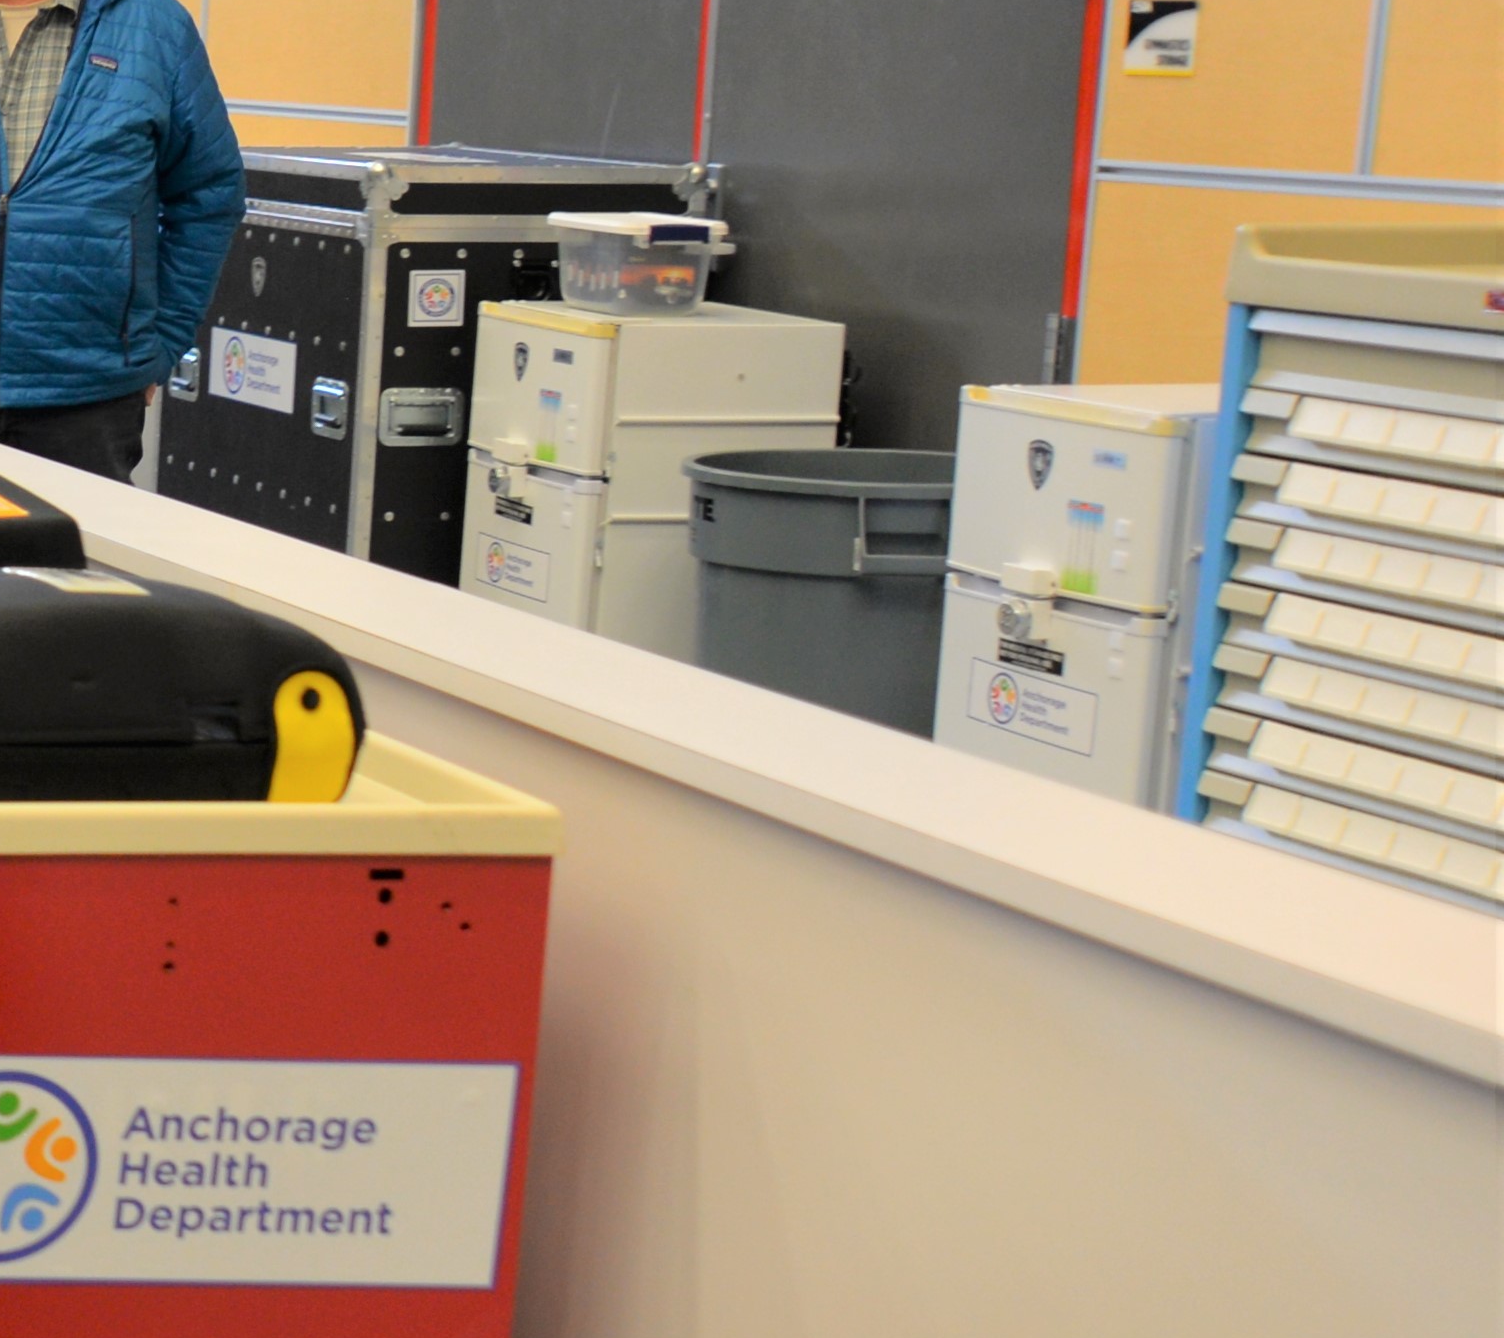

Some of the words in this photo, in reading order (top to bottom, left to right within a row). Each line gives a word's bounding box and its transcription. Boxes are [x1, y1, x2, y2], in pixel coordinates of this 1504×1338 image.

[121, 1106, 377, 1151] Anchorage
[118, 1152, 269, 1188] Health
[113, 1197, 393, 1239] Department
